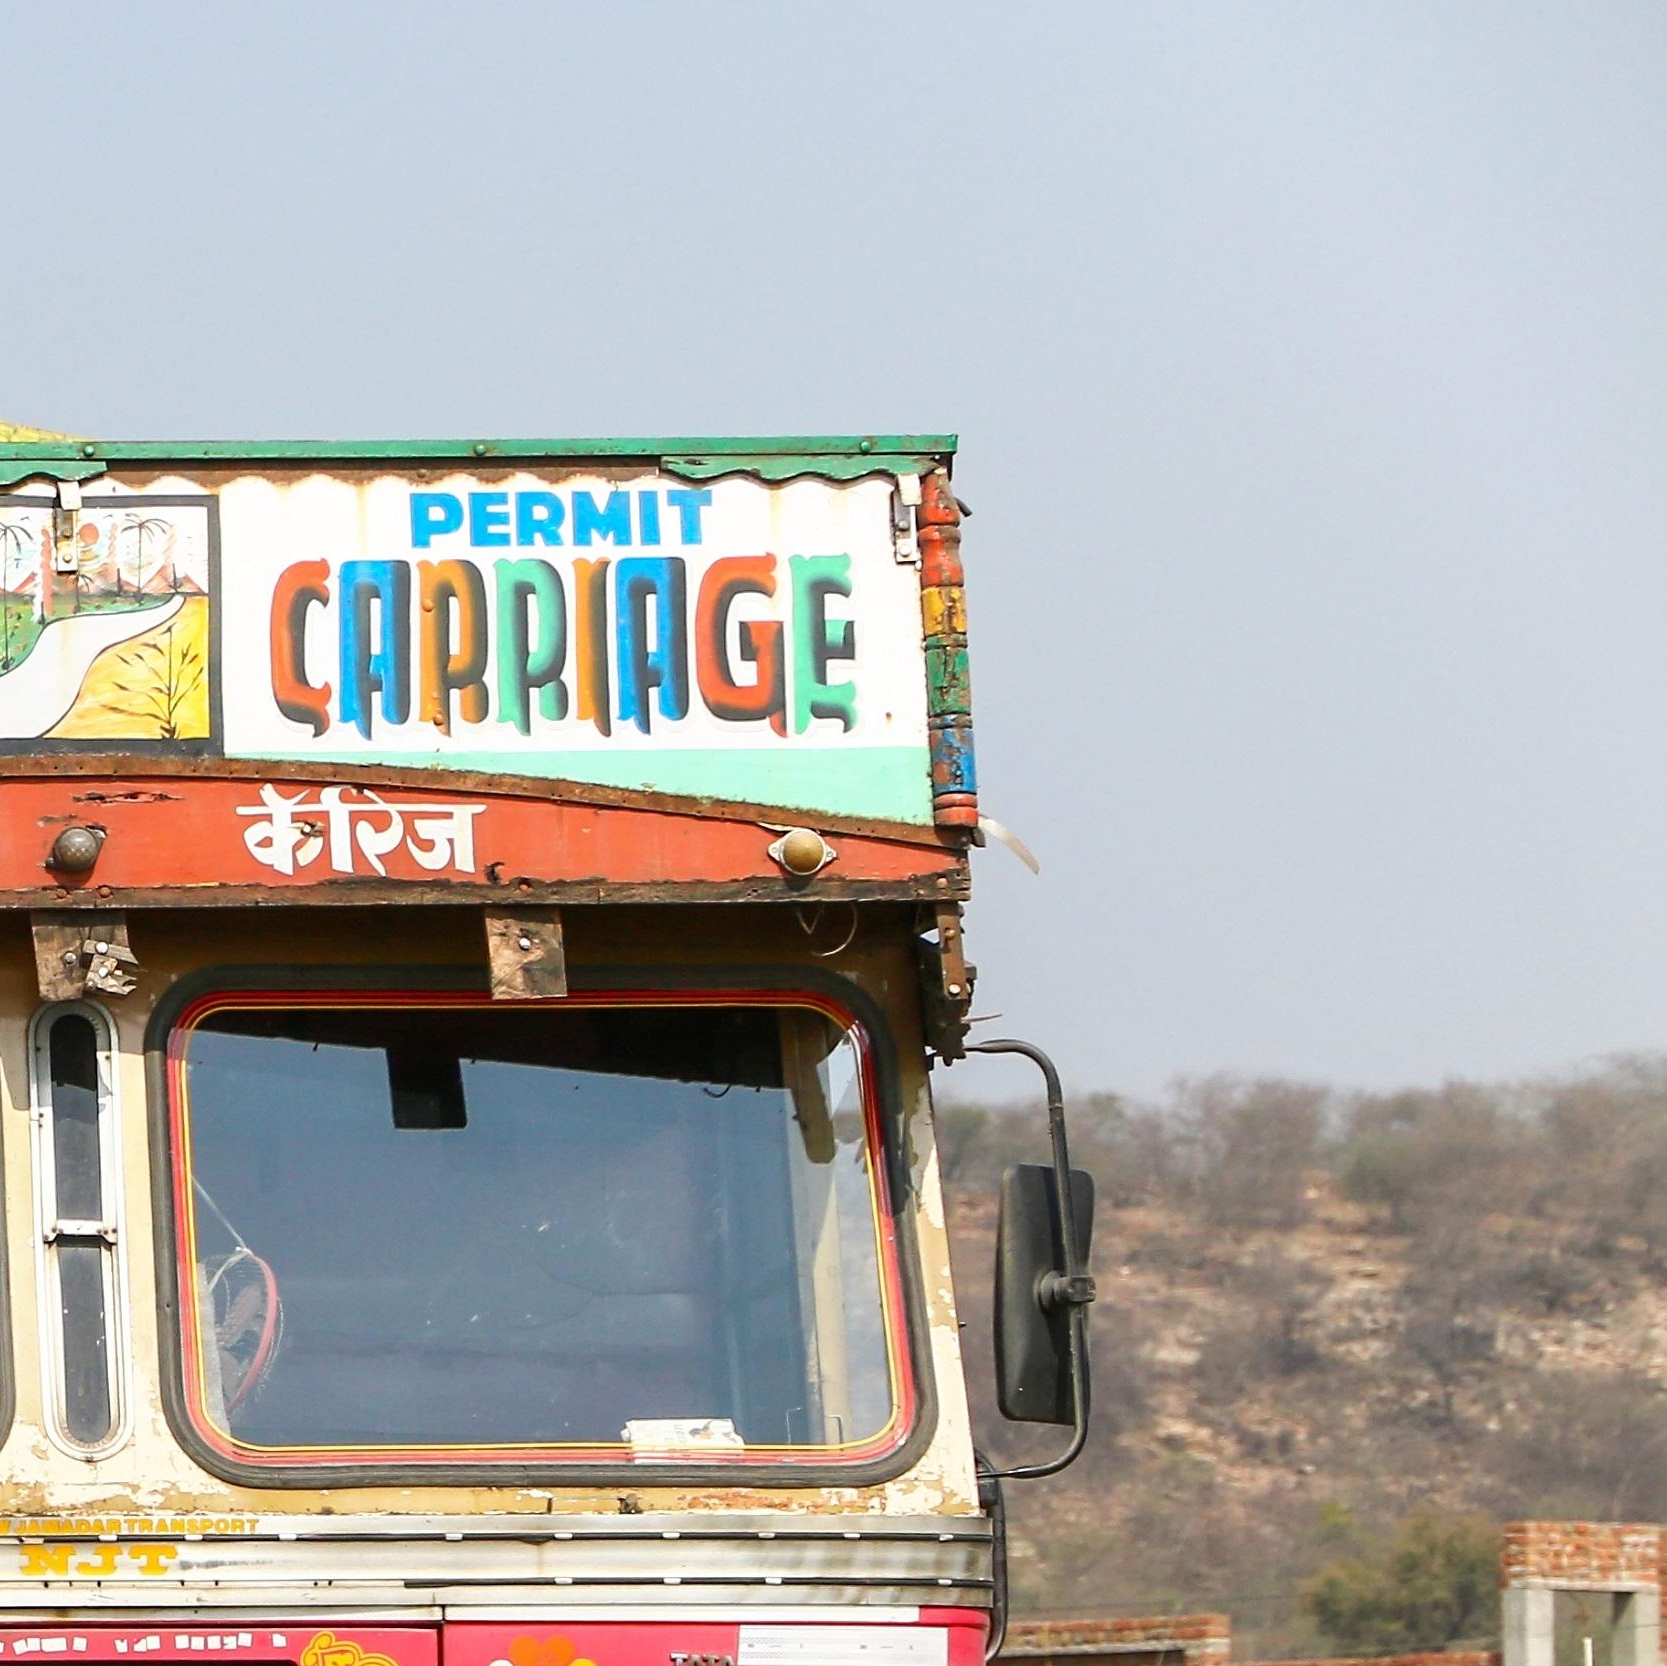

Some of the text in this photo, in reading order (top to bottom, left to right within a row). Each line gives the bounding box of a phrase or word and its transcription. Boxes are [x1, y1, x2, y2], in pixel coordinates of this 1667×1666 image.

[409, 489, 712, 547] PERMIT
[270, 553, 856, 737] CARRIAGE
[124, 1518, 259, 1534] TRANSPORT
[19, 1544, 177, 1575] NJT
